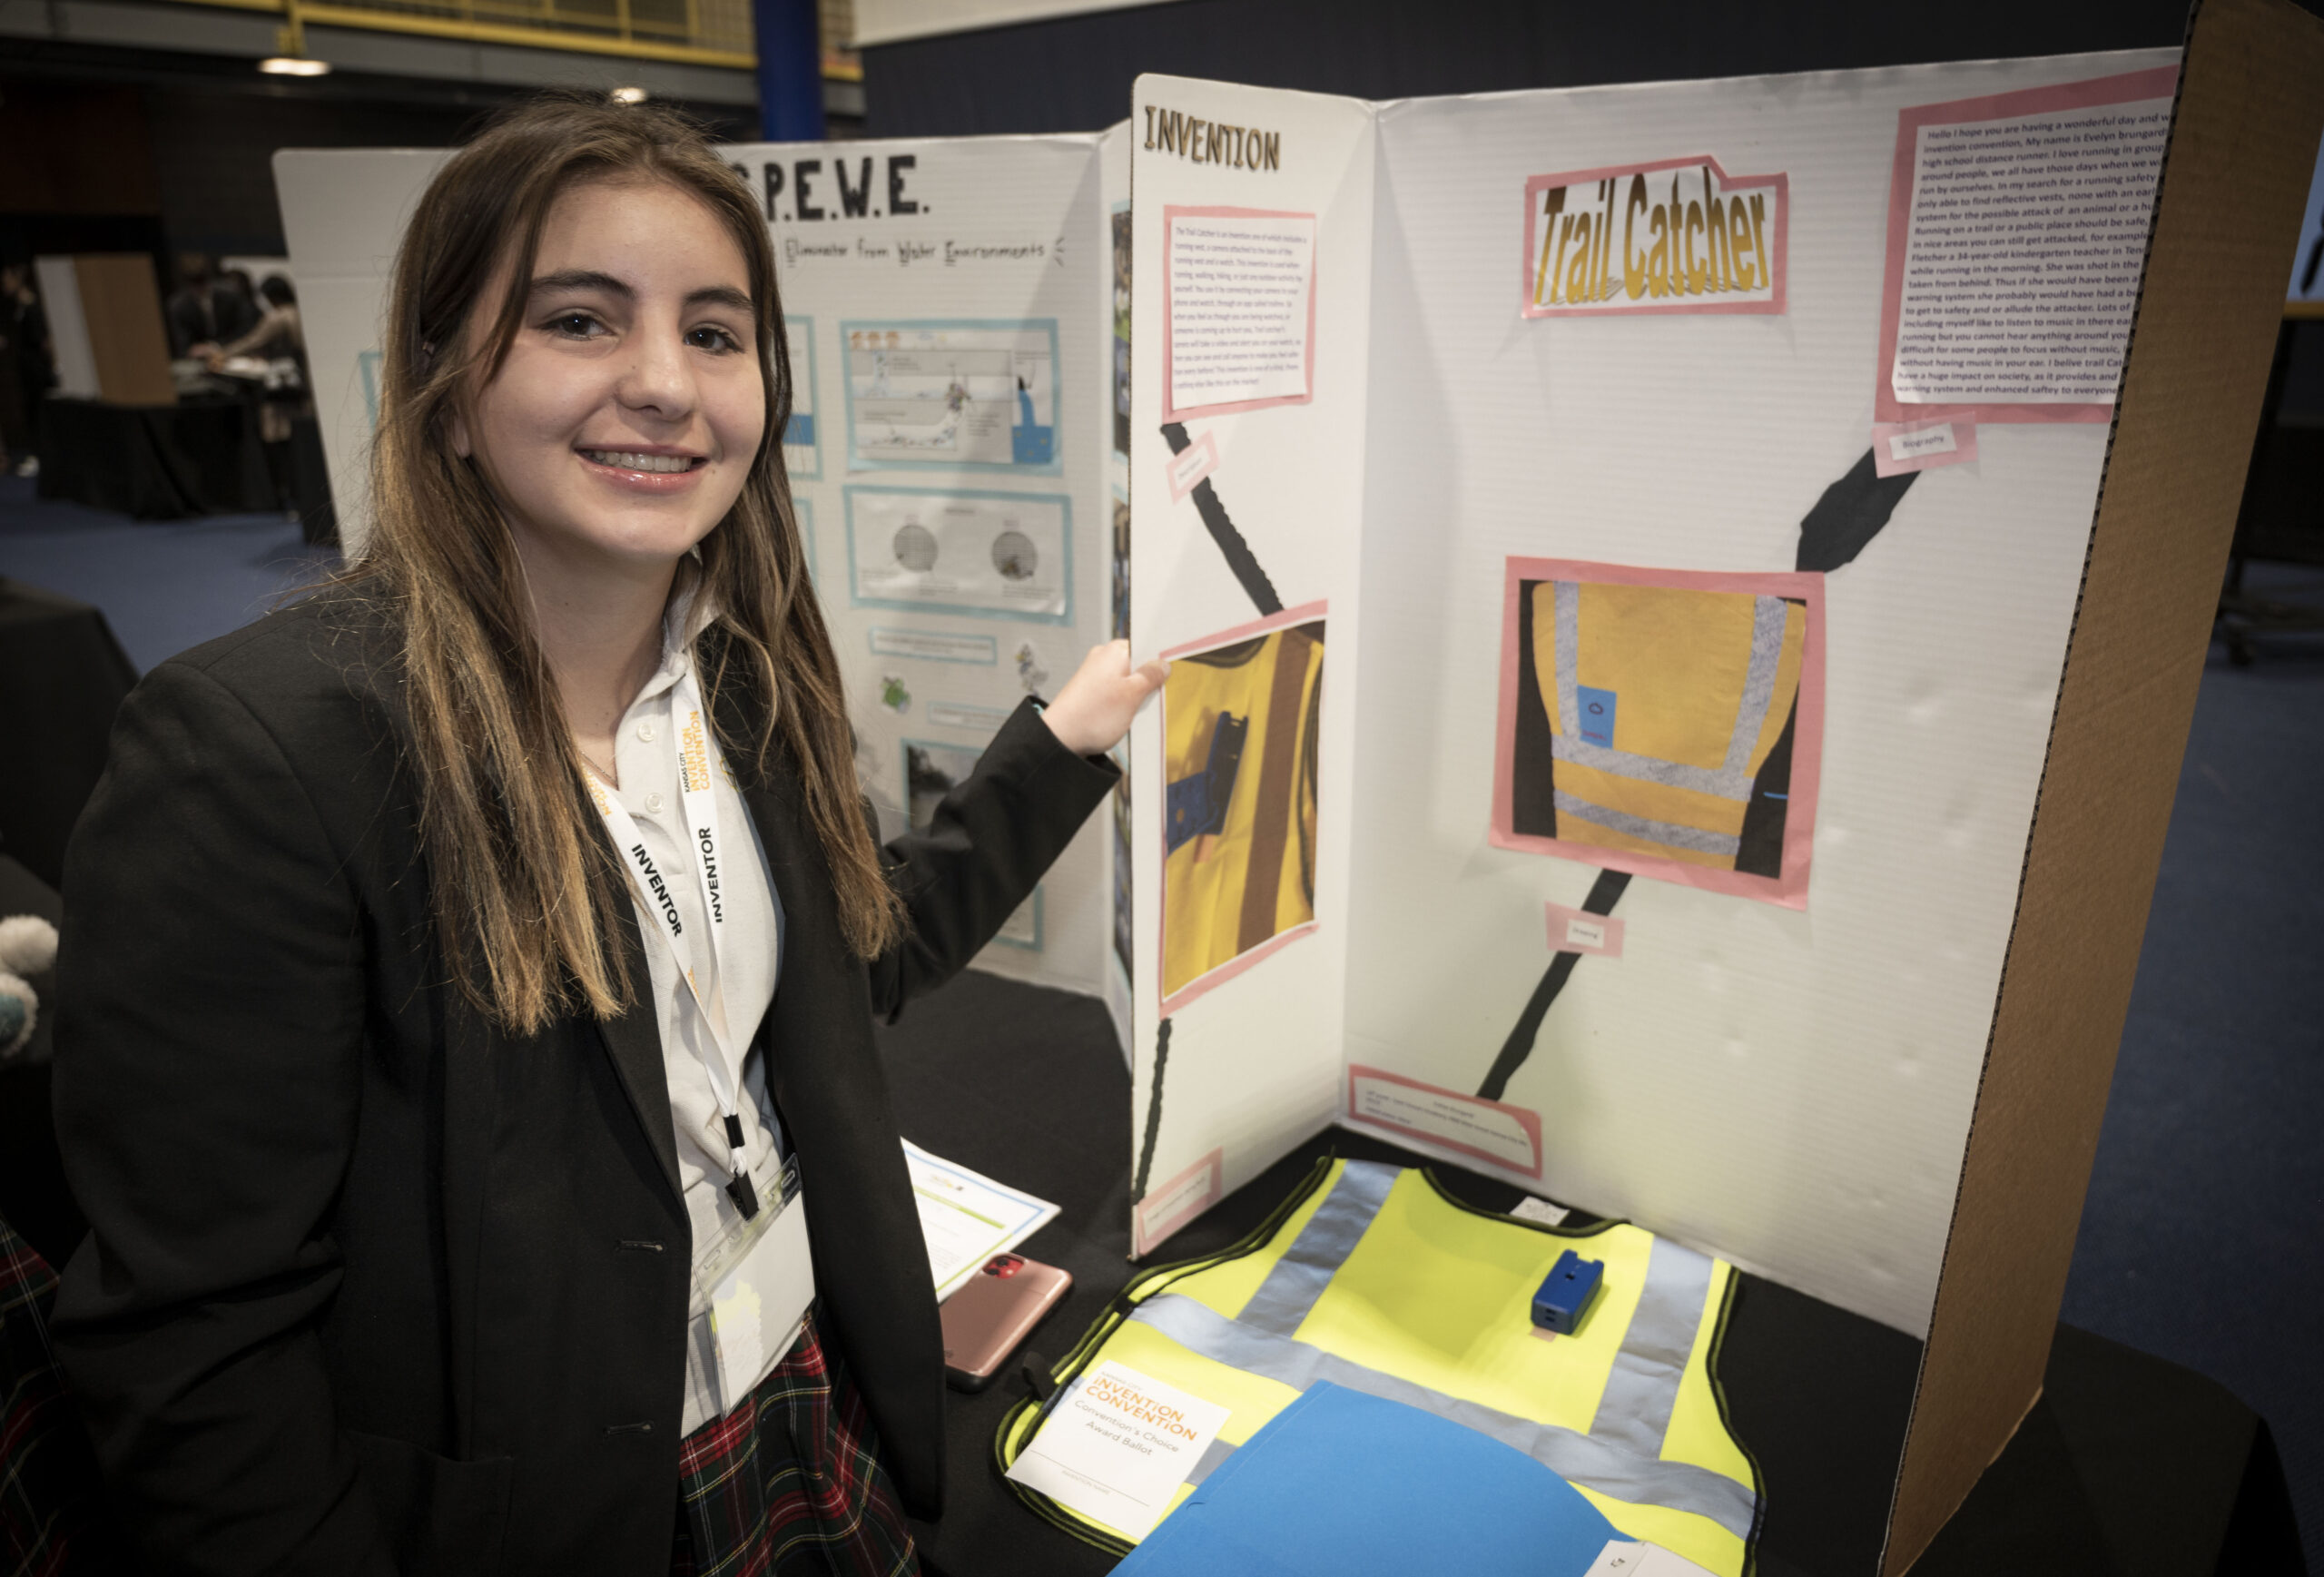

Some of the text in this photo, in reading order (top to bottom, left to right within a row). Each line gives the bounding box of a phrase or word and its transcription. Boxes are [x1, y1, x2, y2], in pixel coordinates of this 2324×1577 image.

[1927, 130, 1952, 139] Hello
[1958, 127, 1983, 138] hope
[1984, 128, 2003, 136] you
[2021, 122, 2053, 133] having
[2063, 117, 2116, 128] wonderful
[2117, 115, 2136, 126] day
[2138, 113, 2159, 123] and
[1145, 105, 1280, 171] INVENTION
[1924, 143, 1967, 153] invention
[1968, 139, 2024, 151] convention,
[2025, 137, 2042, 147] My
[2083, 133, 2116, 143] Evelyn
[1922, 157, 1943, 168] high
[1944, 155, 1974, 164] school
[1974, 153, 2014, 163] distance
[2015, 152, 2050, 160] runner.
[2058, 148, 2080, 157] love
[2081, 146, 2121, 157] running
[1921, 171, 1954, 180] around
[1955, 169, 1989, 180] people,
[2007, 167, 2020, 175] all
[2021, 165, 2044, 174] have
[2046, 163, 2074, 172] those
[2075, 163, 2098, 172] days
[2101, 161, 2129, 170] when
[1936, 185, 1948, 195] by
[1949, 182, 1995, 192] ourselves.
[1997, 182, 2008, 190] In
[2008, 182, 2024, 191] my
[2025, 179, 2058, 188] search
[2059, 178, 2073, 186] for
[2083, 176, 2123, 187] running
[2125, 173, 2156, 184] safety
[1916, 199, 1937, 209] only
[1938, 198, 1959, 206] able
[1960, 197, 1971, 205] to
[1972, 196, 1991, 204] find
[1992, 193, 2036, 203] reflective
[2038, 192, 2065, 202] vests,
[2095, 190, 2118, 198] with
[1915, 212, 1947, 223] system
[1948, 212, 1963, 220] for
[1964, 211, 1980, 219] the
[1981, 209, 2020, 220] possible
[2021, 207, 2051, 216] attack
[2082, 204, 2117, 213] animal
[1533, 165, 1769, 305] Trail Catcher
[1915, 225, 1952, 236] Running
[1974, 223, 1994, 232] trail
[2014, 222, 2044, 232] public
[2046, 221, 2073, 231] place
[2074, 219, 2108, 228] should
[2110, 219, 2123, 227] be
[2124, 218, 2148, 227] safe,
[1970, 239, 1987, 247] you
[2007, 236, 2025, 244] still
[2025, 235, 2042, 245] get
[2043, 234, 2088, 243] attacked,
[2090, 233, 2105, 241] for
[1911, 252, 1947, 261] Fletcher
[2010, 248, 2071, 260] kindergarten
[2073, 247, 2111, 255] teacher
[1909, 266, 1935, 274] while
[1935, 266, 1971, 276] running
[1983, 264, 1999, 272] the
[2000, 264, 2043, 274] morning.
[2086, 261, 2109, 270] shot
[2122, 261, 2140, 269] the
[1908, 280, 1934, 288] taken
[1935, 279, 1957, 287] from
[1958, 279, 1992, 287] behind.
[1994, 278, 2017, 286] Thus
[2027, 277, 2044, 285] she
[2046, 276, 2077, 284] would
[2078, 276, 2102, 284] have
[2104, 275, 2130, 283] been
[1903, 435, 1945, 449] Biography
[682, 727, 701, 791] INVENTION
[689, 710, 711, 791] CONVENTION
[698, 827, 723, 922] INVENTOR
[631, 843, 682, 938] INVENTOR
[1075, 1399, 1179, 1453] Convention's Choice
[1086, 1420, 1154, 1456] Award Ballot
